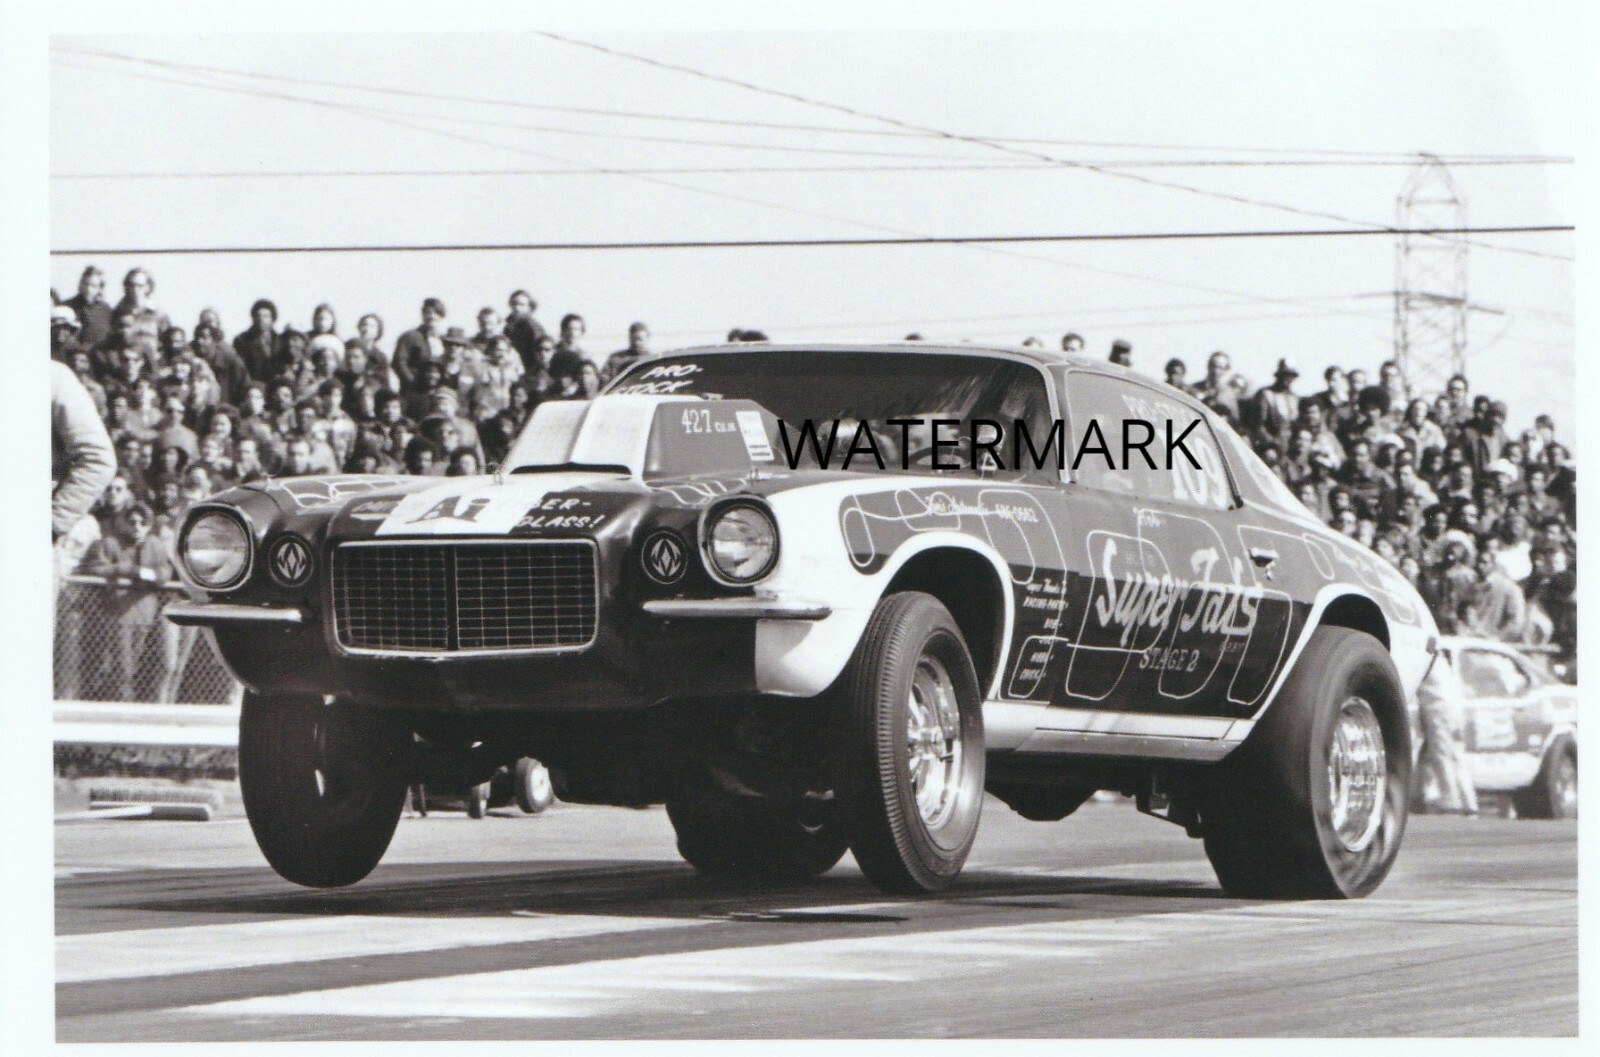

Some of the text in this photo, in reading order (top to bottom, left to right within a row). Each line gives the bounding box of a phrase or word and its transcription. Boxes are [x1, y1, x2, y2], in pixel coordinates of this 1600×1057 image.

[681, 408, 712, 433] 427
[1096, 538, 1190, 647] Super
[1139, 647, 1188, 670] STAGE
